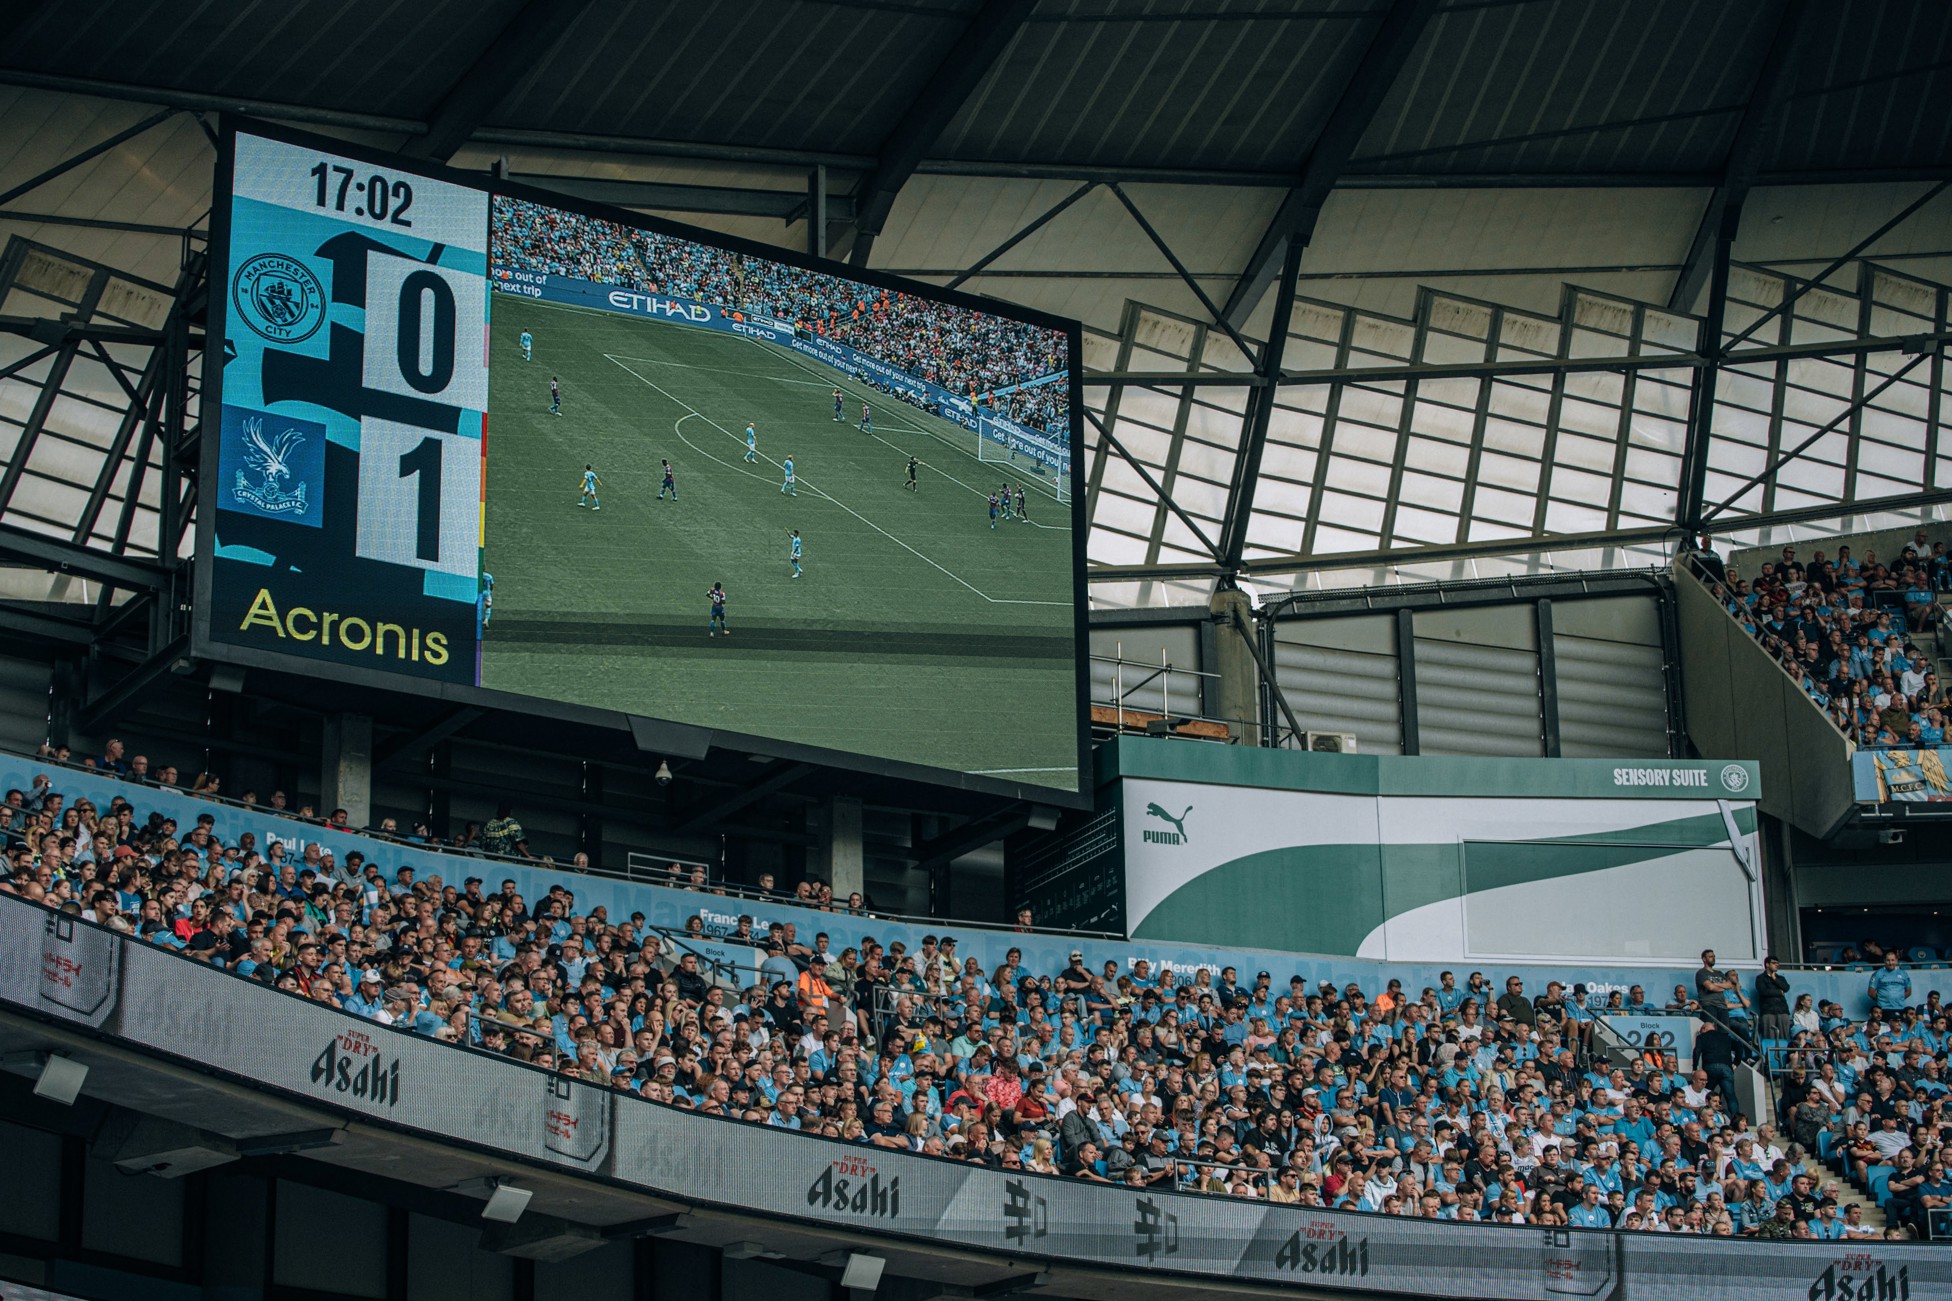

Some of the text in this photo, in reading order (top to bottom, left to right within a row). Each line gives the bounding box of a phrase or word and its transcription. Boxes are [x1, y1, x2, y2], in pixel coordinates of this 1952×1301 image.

[311, 162, 412, 227] 17:02
[244, 260, 316, 295] MANCHESTER
[514, 271, 534, 283] out
[535, 274, 547, 285] of
[523, 284, 542, 298] trip
[608, 290, 712, 323] ETIHAD
[265, 325, 292, 337] CITY
[397, 269, 456, 394] 0
[732, 323, 776, 340] ETIHAD
[815, 338, 842, 354] ETIHAD
[992, 429, 1004, 441] Get
[1024, 444, 1036, 456] out
[1037, 450, 1046, 460] of
[237, 489, 266, 508] CRYSTAL
[265, 501, 291, 511] PALACE
[398, 436, 442, 563] 1
[240, 589, 450, 665] Acronis
[1613, 768, 1671, 786] SENSORY
[1672, 769, 1709, 787] SUITE
[1143, 830, 1180, 846] PUMA
[705, 947, 726, 957] Block
[311, 1038, 399, 1108] Asahi
[807, 1164, 900, 1220] Asahi
[1275, 1230, 1368, 1278] Asahi
[1808, 1264, 1910, 1301] Asahi
